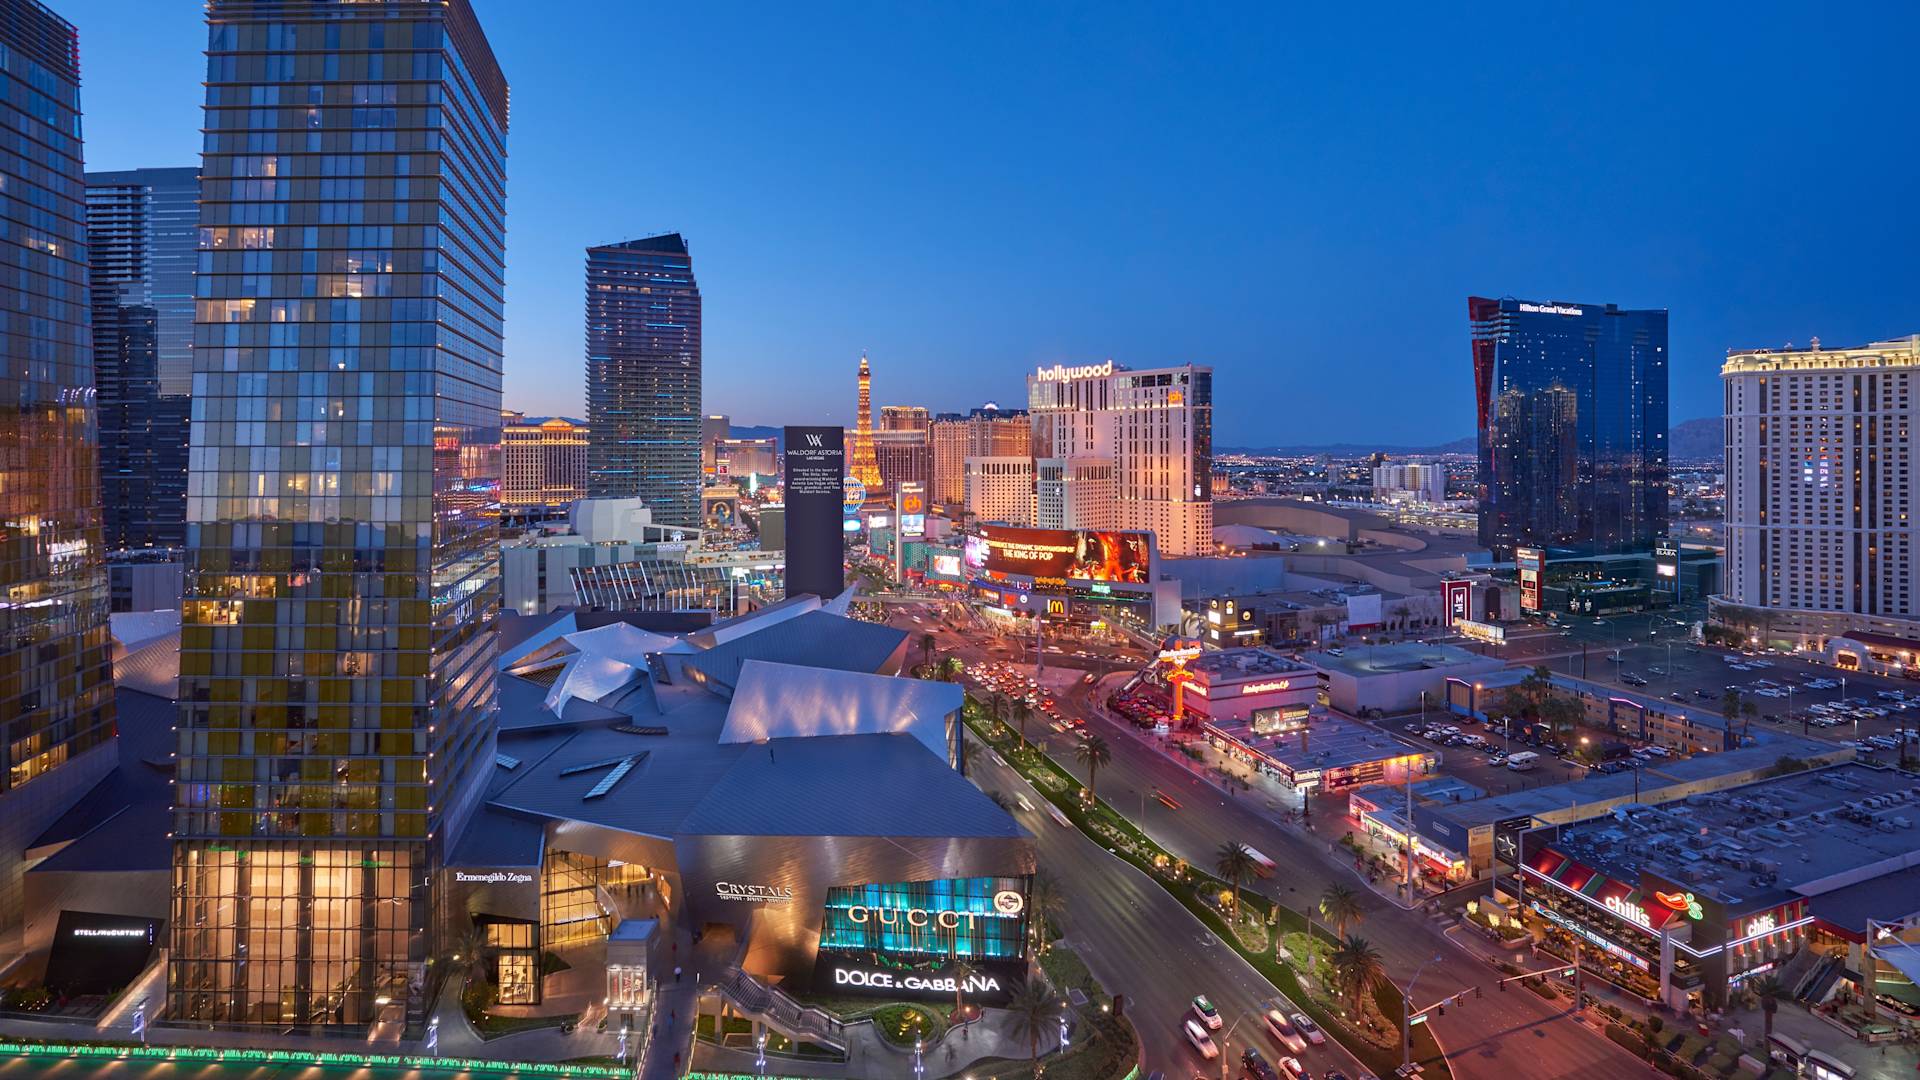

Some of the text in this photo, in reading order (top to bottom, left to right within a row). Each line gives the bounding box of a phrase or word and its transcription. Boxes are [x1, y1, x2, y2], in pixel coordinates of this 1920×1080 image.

[1520, 304, 1583, 315] Hilton Grand Vacations
[1037, 360, 1112, 383] hollywood
[1003, 549, 1054, 560] THE KING OF POP
[1656, 548, 1676, 556] ELARA
[456, 872, 532, 883] Ermenegildo Zegna
[848, 906, 975, 930] GUCCI
[1605, 896, 1650, 927] chili's
[1747, 914, 1775, 936] chili's
[835, 968, 1001, 993] DOLCE & GABBANA
